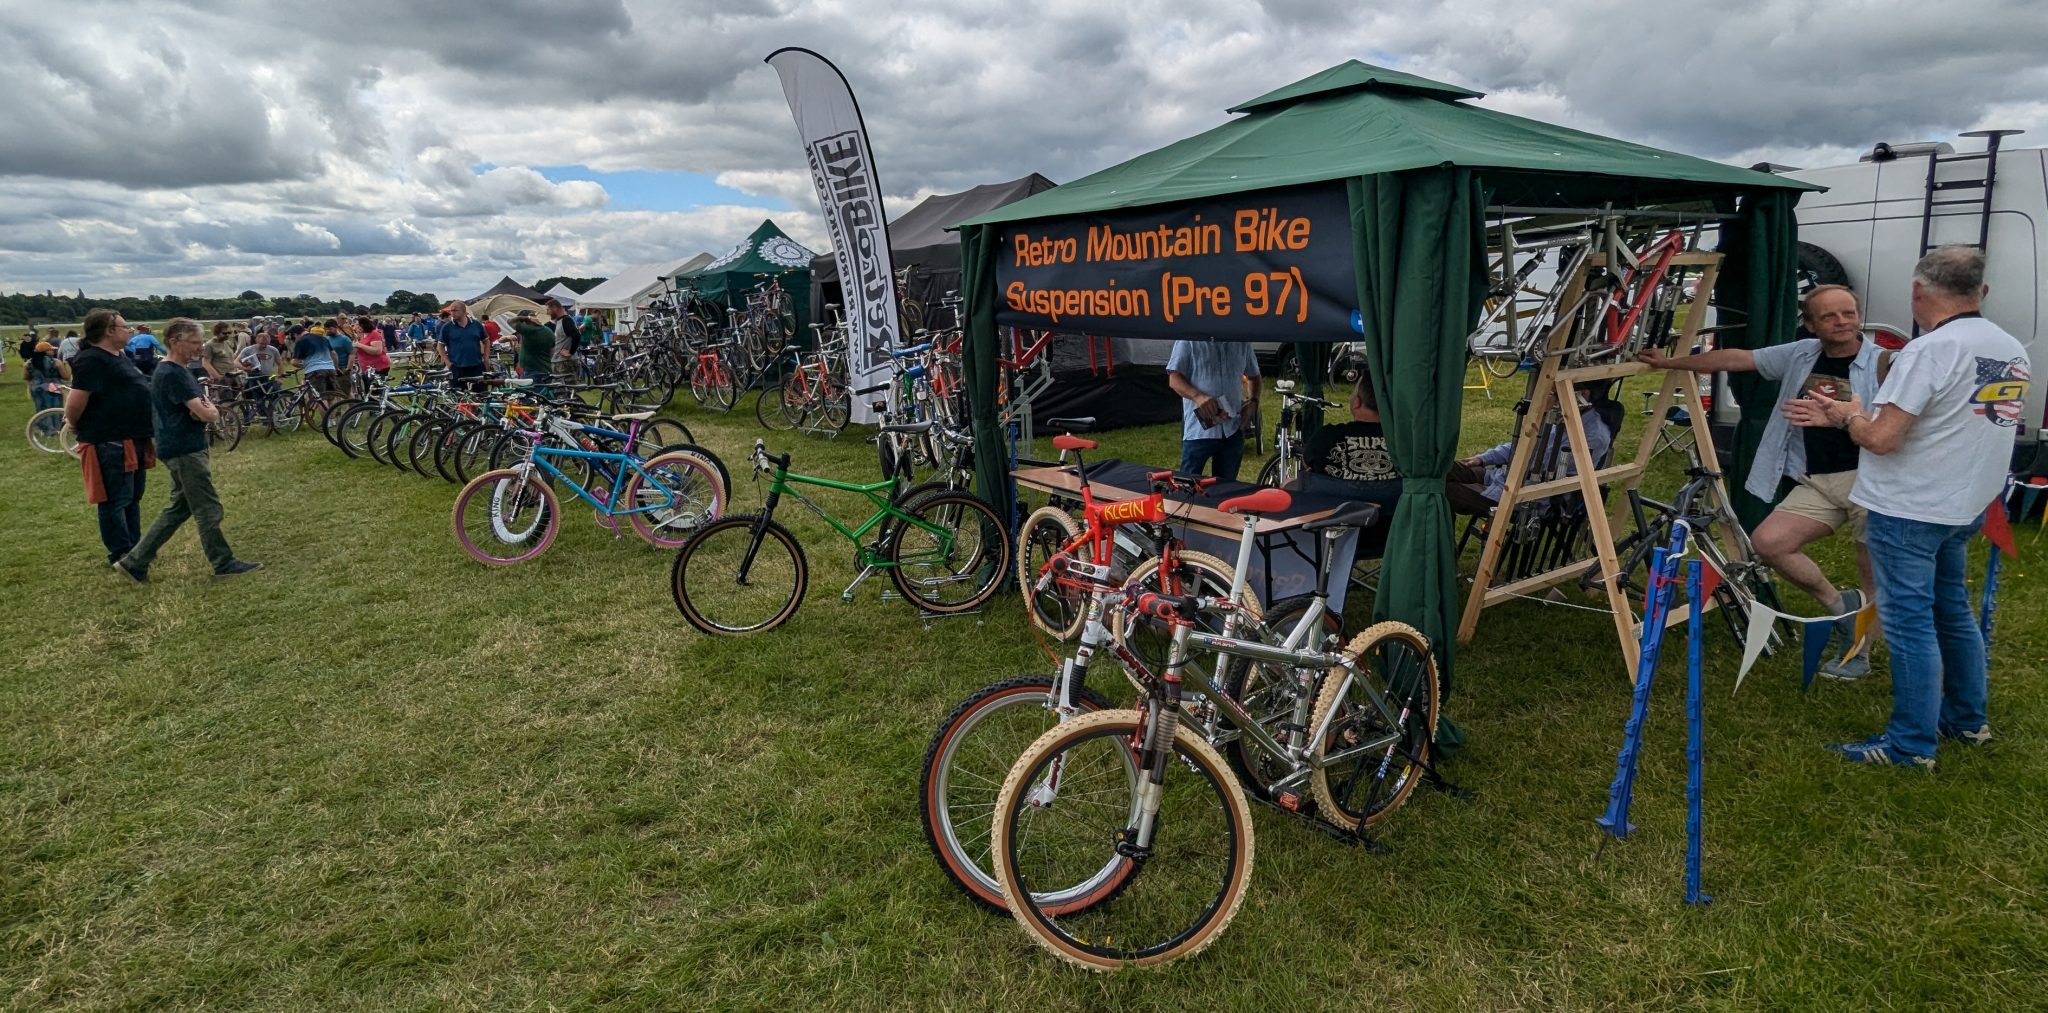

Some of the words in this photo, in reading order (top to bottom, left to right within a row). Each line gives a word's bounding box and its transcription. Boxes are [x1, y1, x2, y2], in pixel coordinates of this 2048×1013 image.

[1015, 233, 1076, 267] Retro
[1086, 214, 1221, 263] Mountain
[1234, 207, 1311, 253] Bike
[1006, 280, 1151, 323] Suspension
[1161, 271, 1231, 323] (Pre
[1245, 266, 1310, 323] 97)
[492, 497, 501, 518] KING
[1104, 501, 1145, 521] KLEIN
